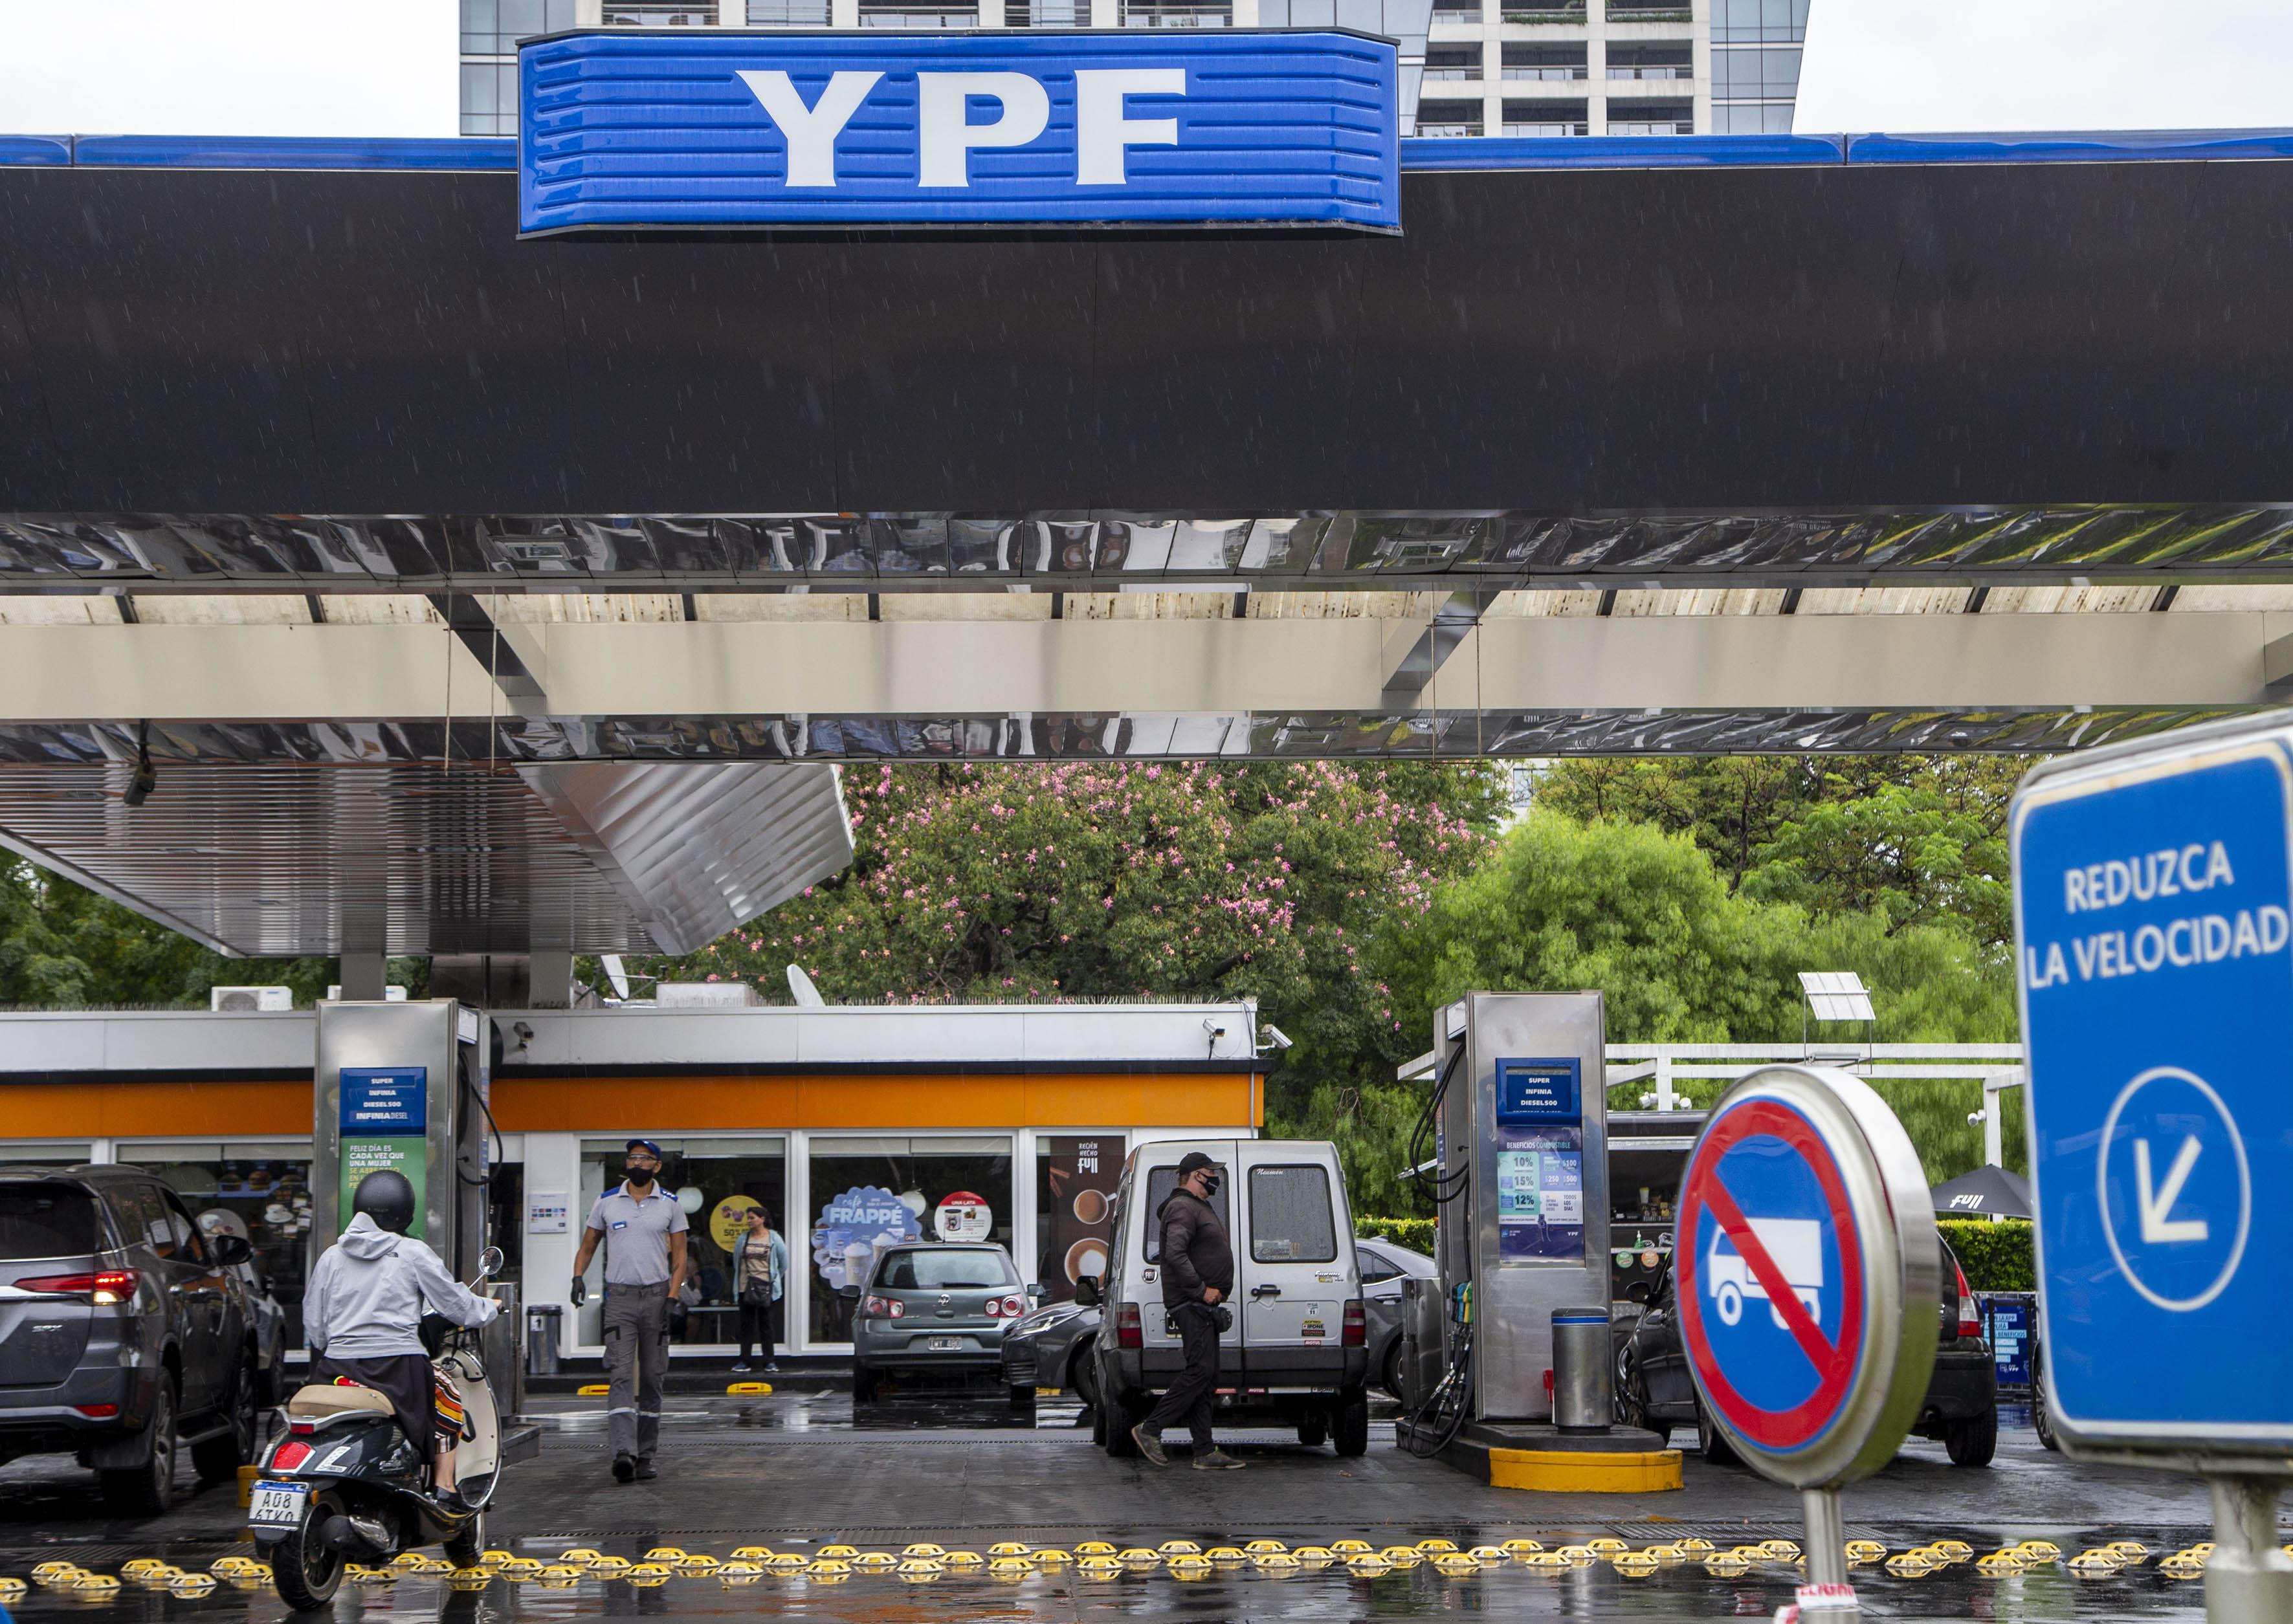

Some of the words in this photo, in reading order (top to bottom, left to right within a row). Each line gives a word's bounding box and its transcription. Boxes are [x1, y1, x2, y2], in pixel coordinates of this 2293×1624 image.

[735, 69, 1186, 187] YPF
[2064, 841, 2235, 914] REDUZCA
[2027, 942, 2069, 989] LA
[2072, 905, 2290, 982] VELOCIDAD
[1078, 1158, 1098, 1174] full
[1514, 1157, 1533, 1167] 10%
[1514, 1176, 1534, 1186] 15%
[1515, 1195, 1534, 1205] 12%
[1949, 1194, 1984, 1209] full
[829, 1205, 903, 1225] FRAPPÉ
